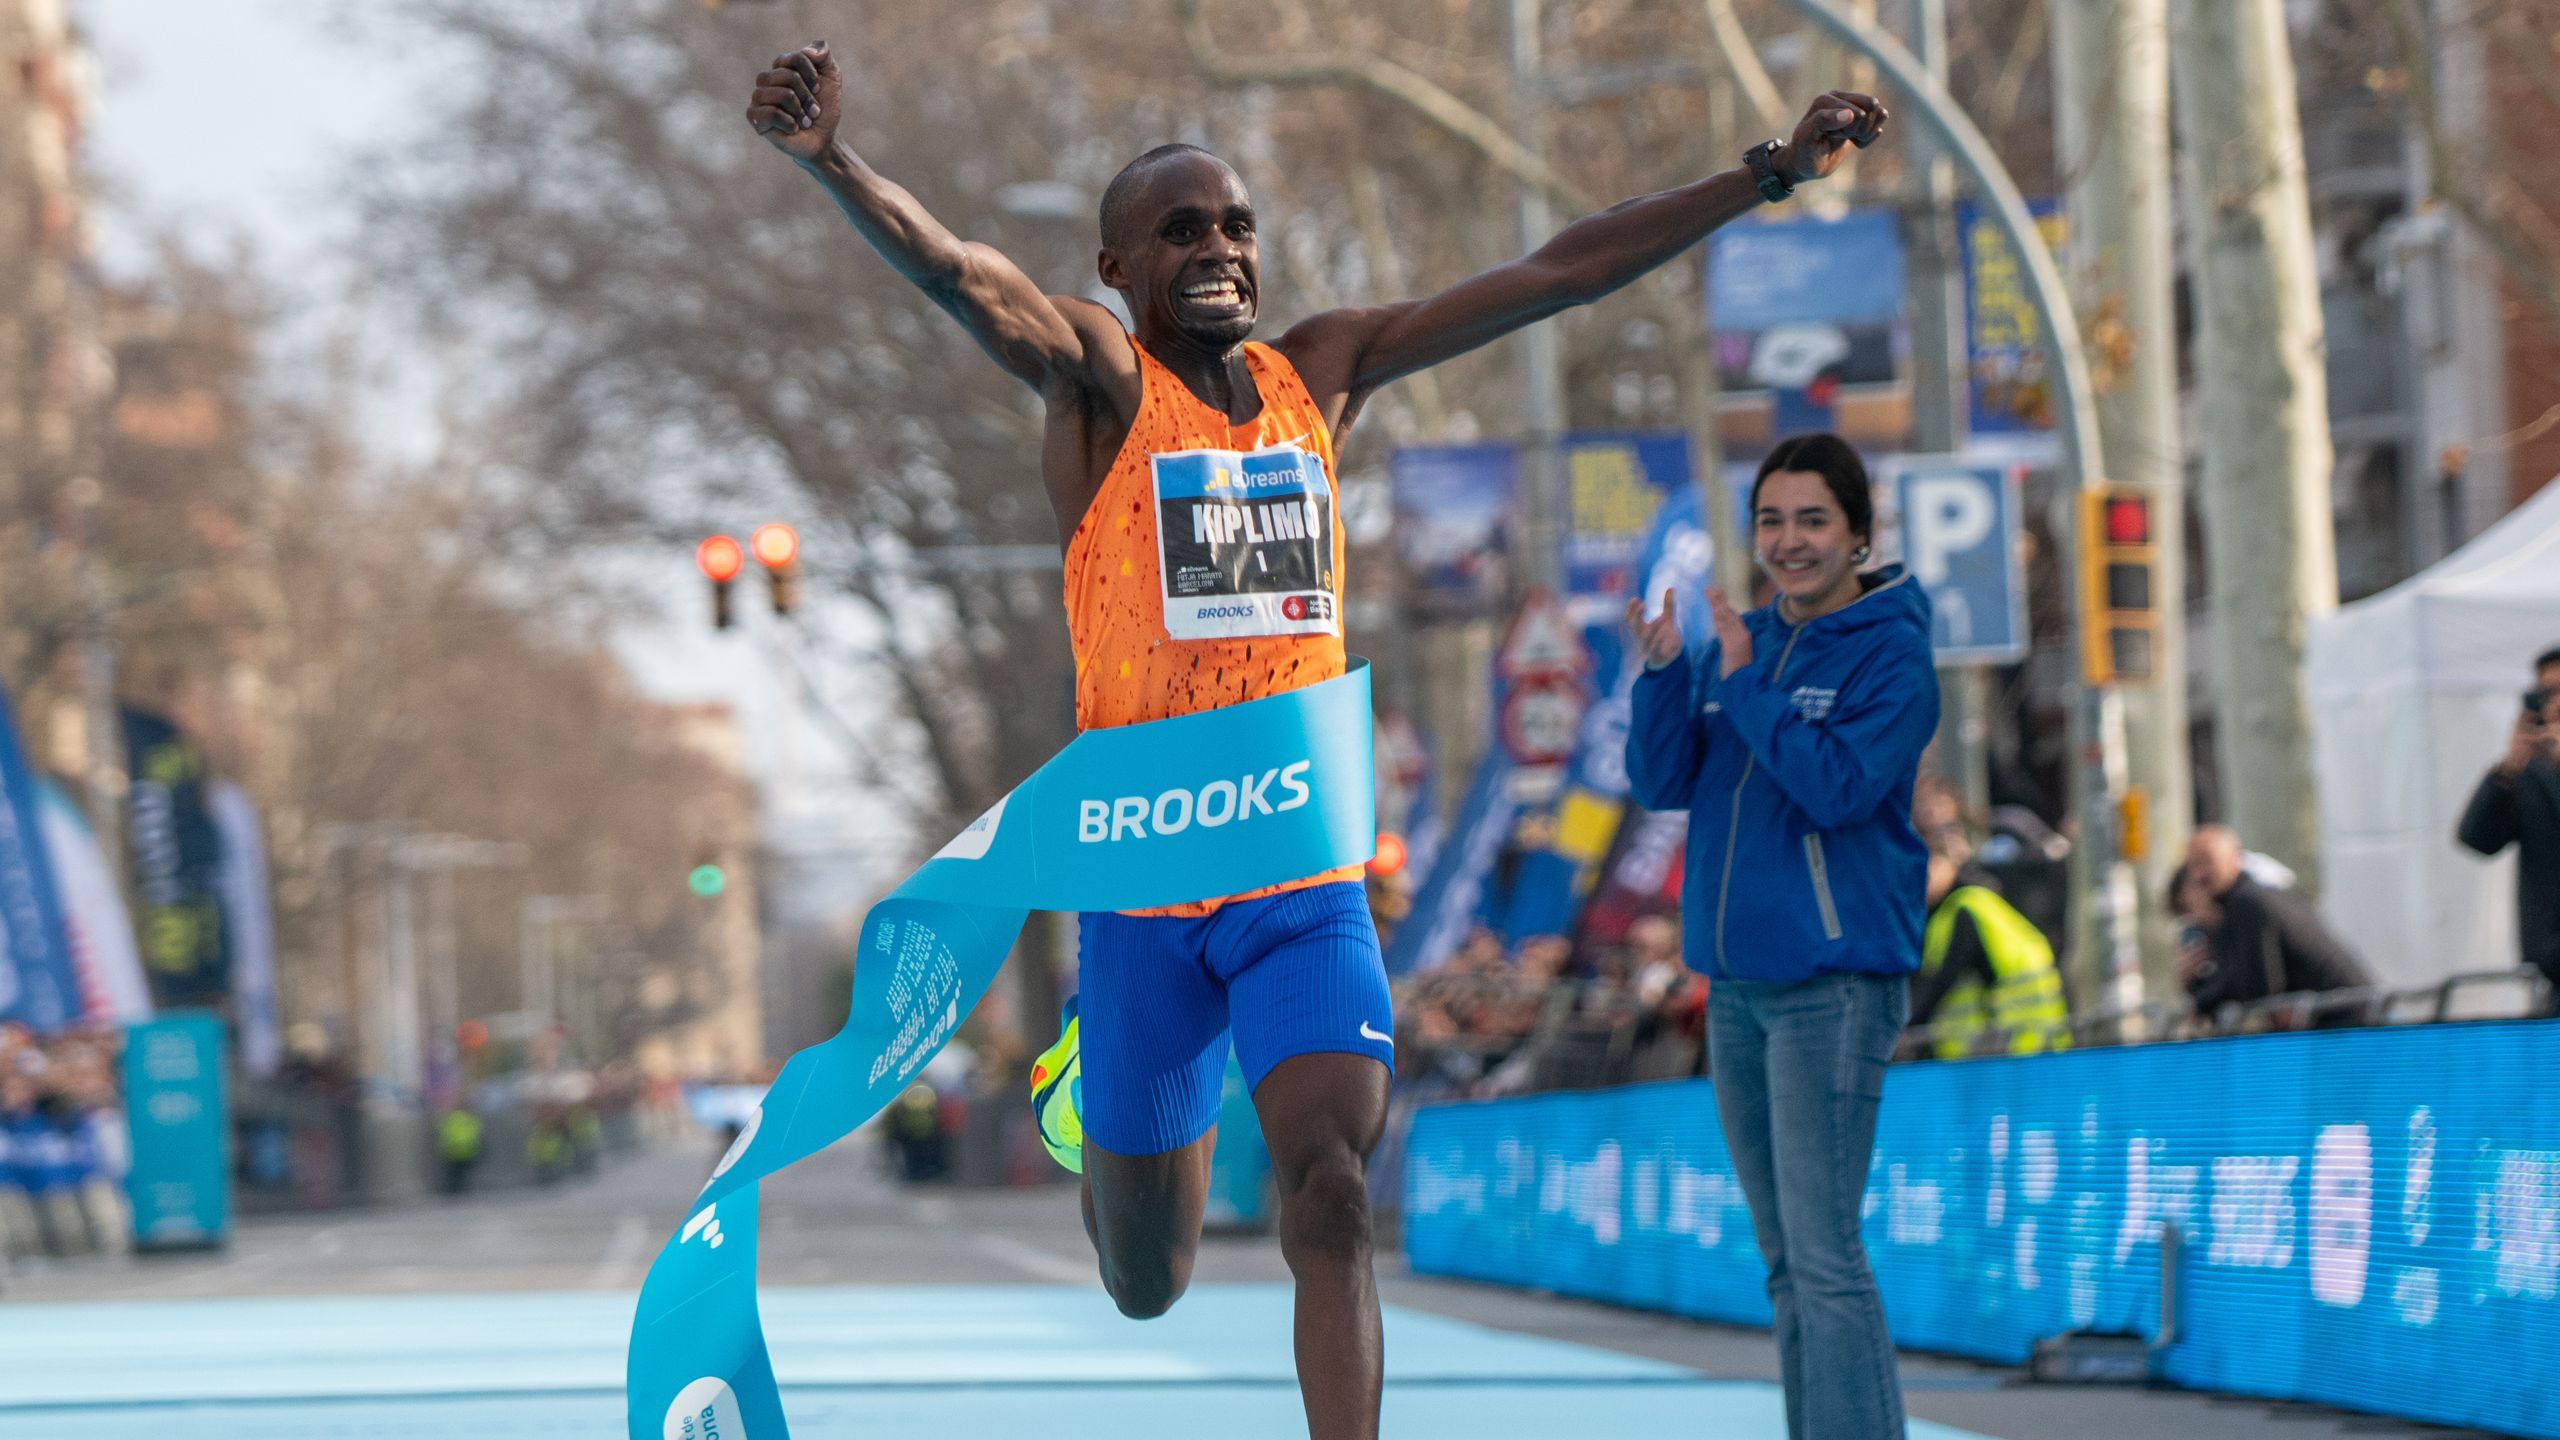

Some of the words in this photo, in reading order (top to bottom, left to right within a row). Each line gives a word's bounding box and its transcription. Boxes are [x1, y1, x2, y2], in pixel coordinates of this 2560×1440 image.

[1232, 468, 1304, 488] eDreams
[1192, 500, 1321, 544] KIPLIMO
[1910, 476, 1995, 585] P
[1255, 550, 1268, 573] 1
[1197, 606, 1255, 619] BROOKS
[1078, 759, 1311, 843] BROOKS
[876, 922, 896, 955] BROOKS
[897, 1014, 946, 1082] eDreams
